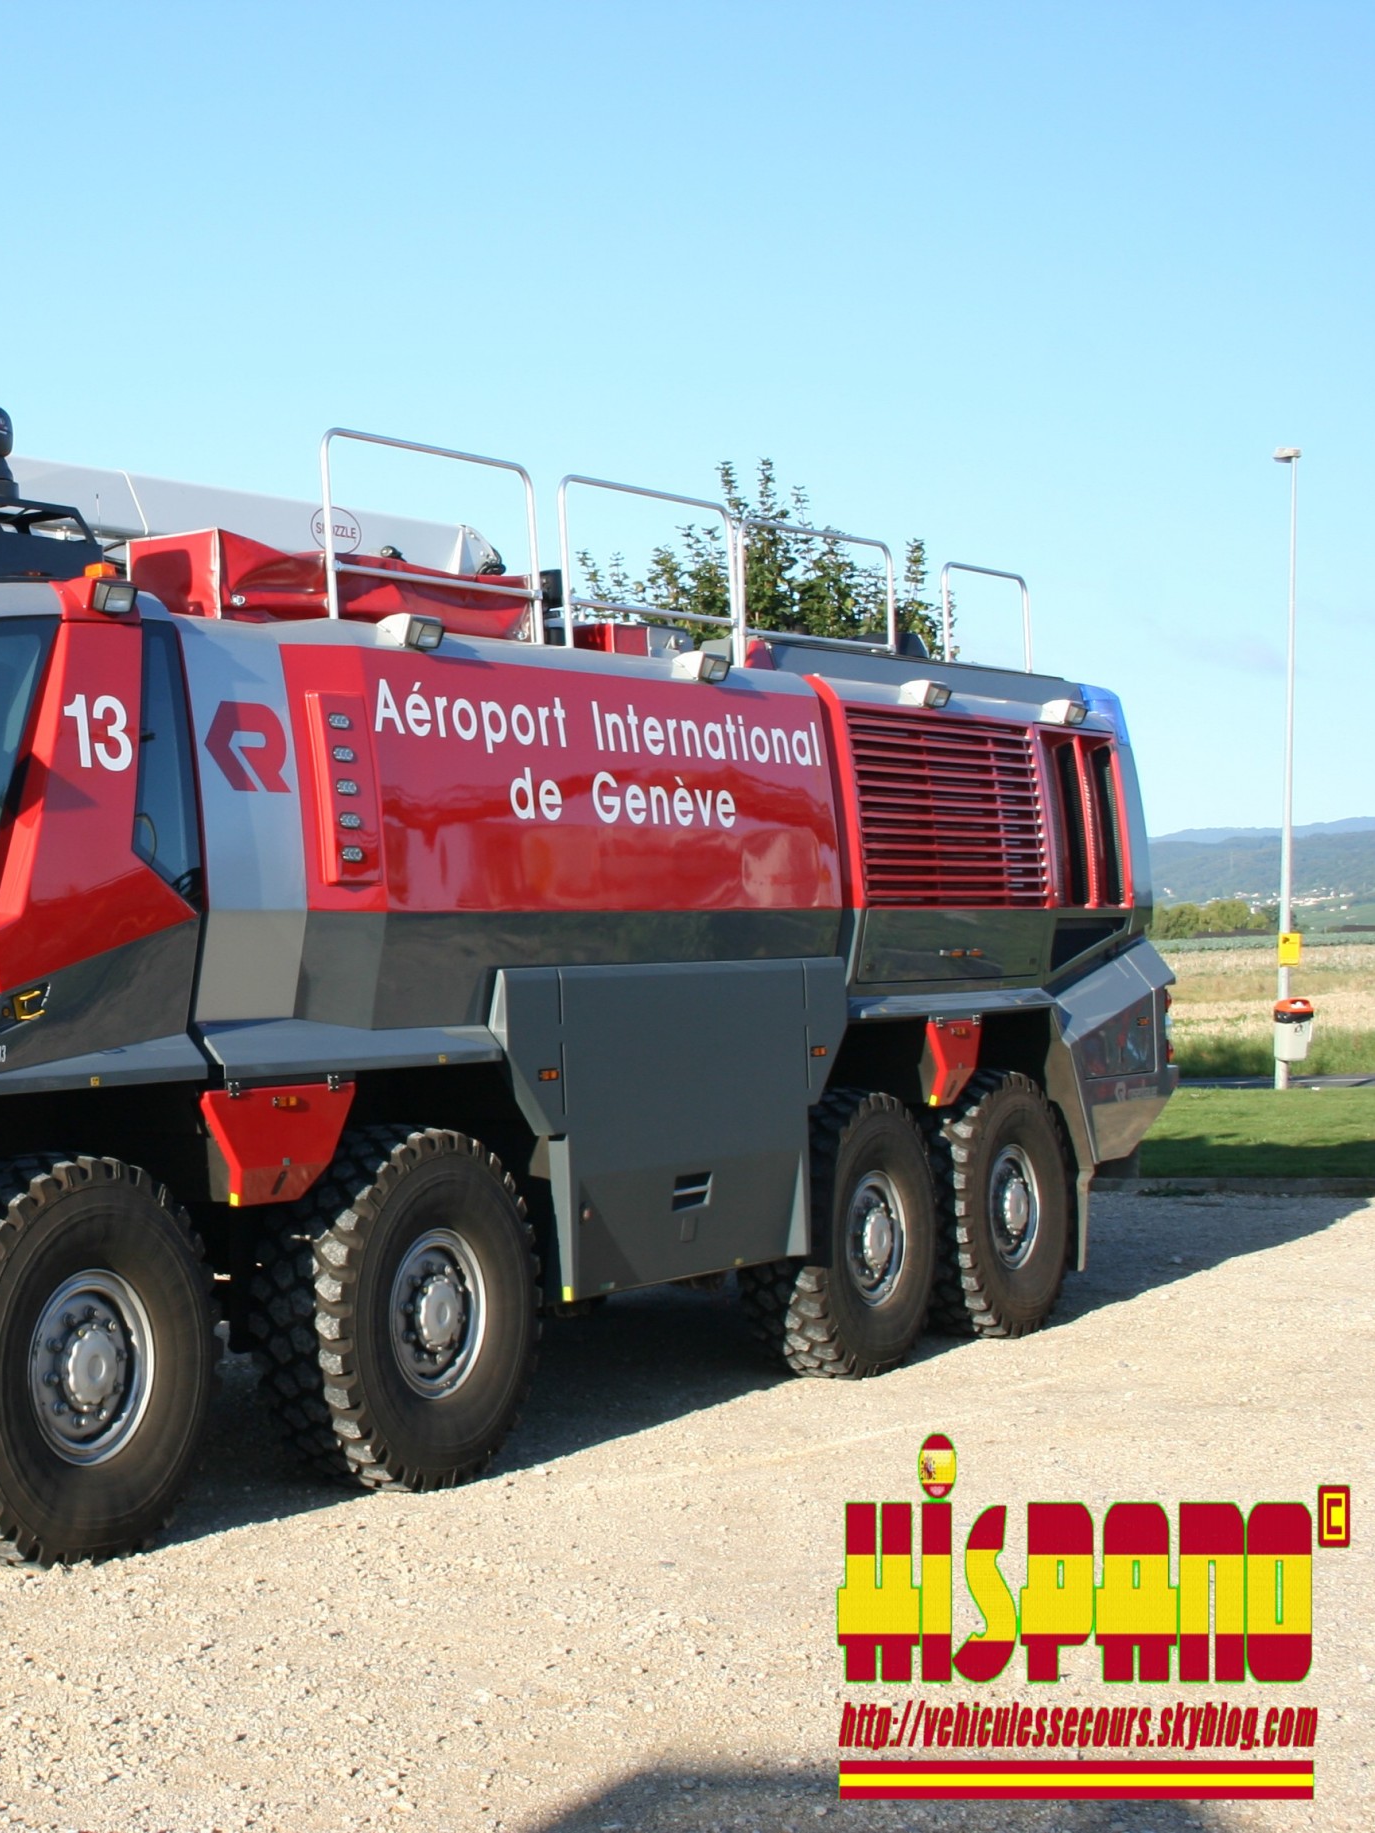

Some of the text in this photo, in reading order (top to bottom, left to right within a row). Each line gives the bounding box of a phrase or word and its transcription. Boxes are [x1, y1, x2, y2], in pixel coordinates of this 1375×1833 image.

[316, 522, 356, 539] SZZLE
[63, 693, 133, 772] 13
[374, 678, 822, 767] Aéroport International
[510, 767, 736, 828] de Genève
